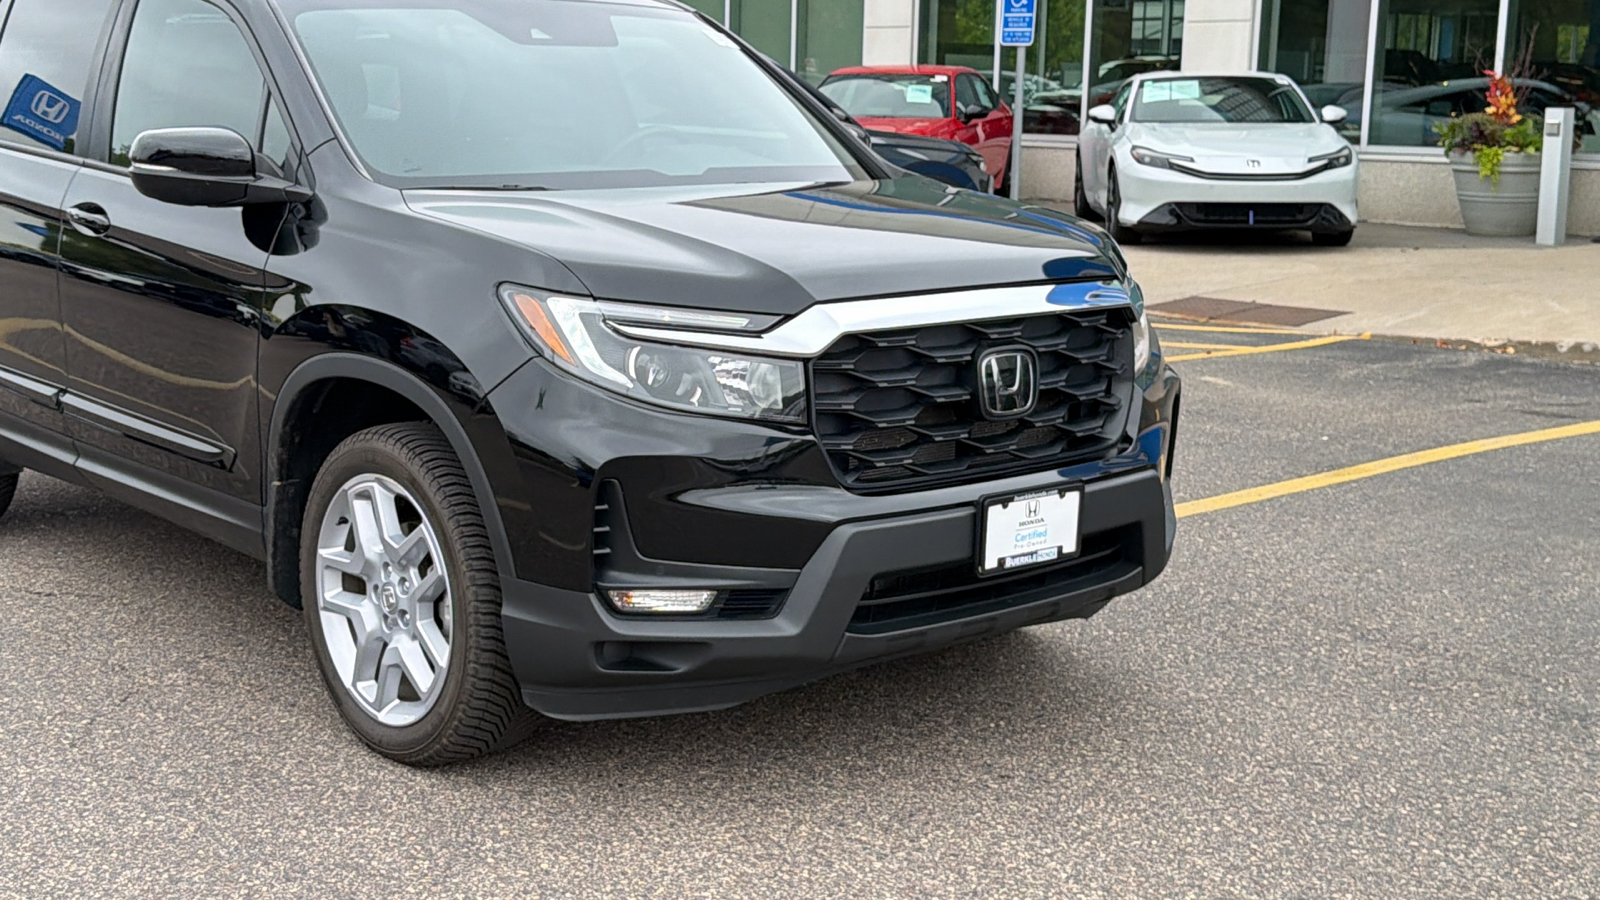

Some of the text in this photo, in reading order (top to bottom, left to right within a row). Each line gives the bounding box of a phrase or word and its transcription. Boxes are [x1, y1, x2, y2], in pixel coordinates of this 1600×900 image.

[1018, 517, 1045, 527] HONDA
[1014, 528, 1048, 542] Certified
[1014, 539, 1047, 549] Pre-Owned
